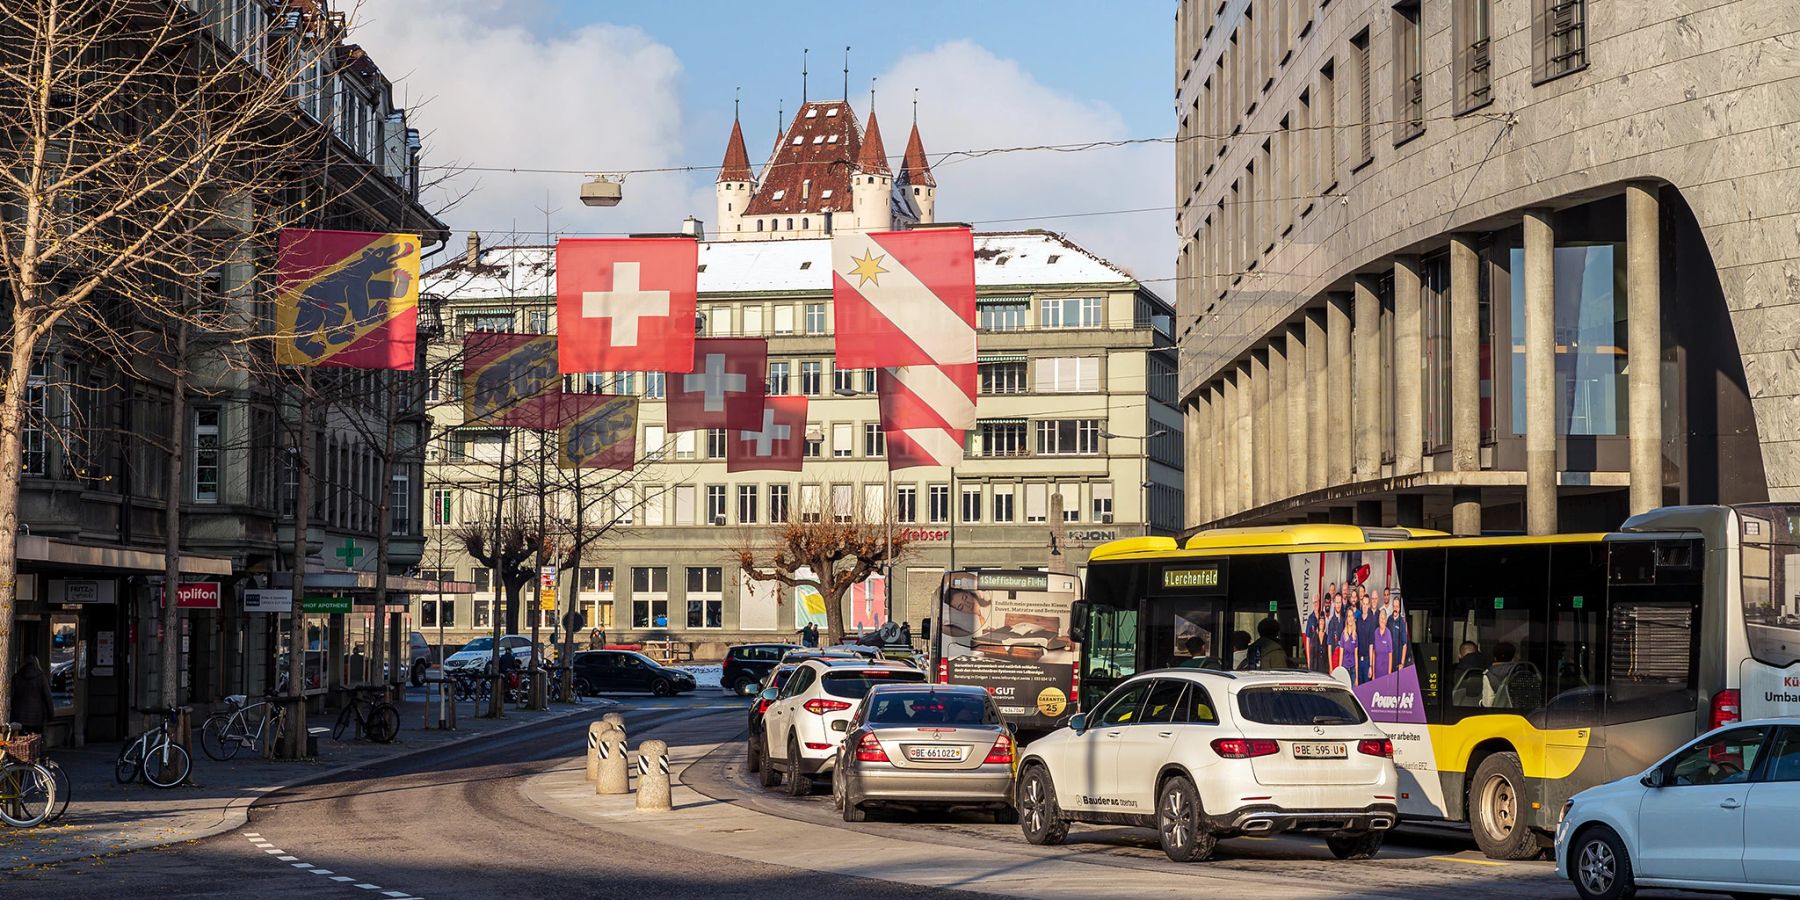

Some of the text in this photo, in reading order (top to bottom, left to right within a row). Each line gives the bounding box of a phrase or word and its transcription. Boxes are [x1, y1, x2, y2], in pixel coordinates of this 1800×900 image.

[901, 527, 949, 541] Krebser
[984, 576, 1026, 587] Steffisburg
[1164, 570, 1218, 586] 4 Lerchenfeld
[163, 588, 217, 602] plifon
[1302, 568, 1310, 625] TILTENTA
[884, 626, 896, 638] 30
[1784, 676, 1800, 687] Kü
[1046, 704, 1058, 713] 25
[1397, 731, 1421, 741] arbeiten
[916, 749, 956, 758] BE 661022
[1301, 745, 1339, 755] BE 595 U
[1083, 795, 1110, 805] Bauder
